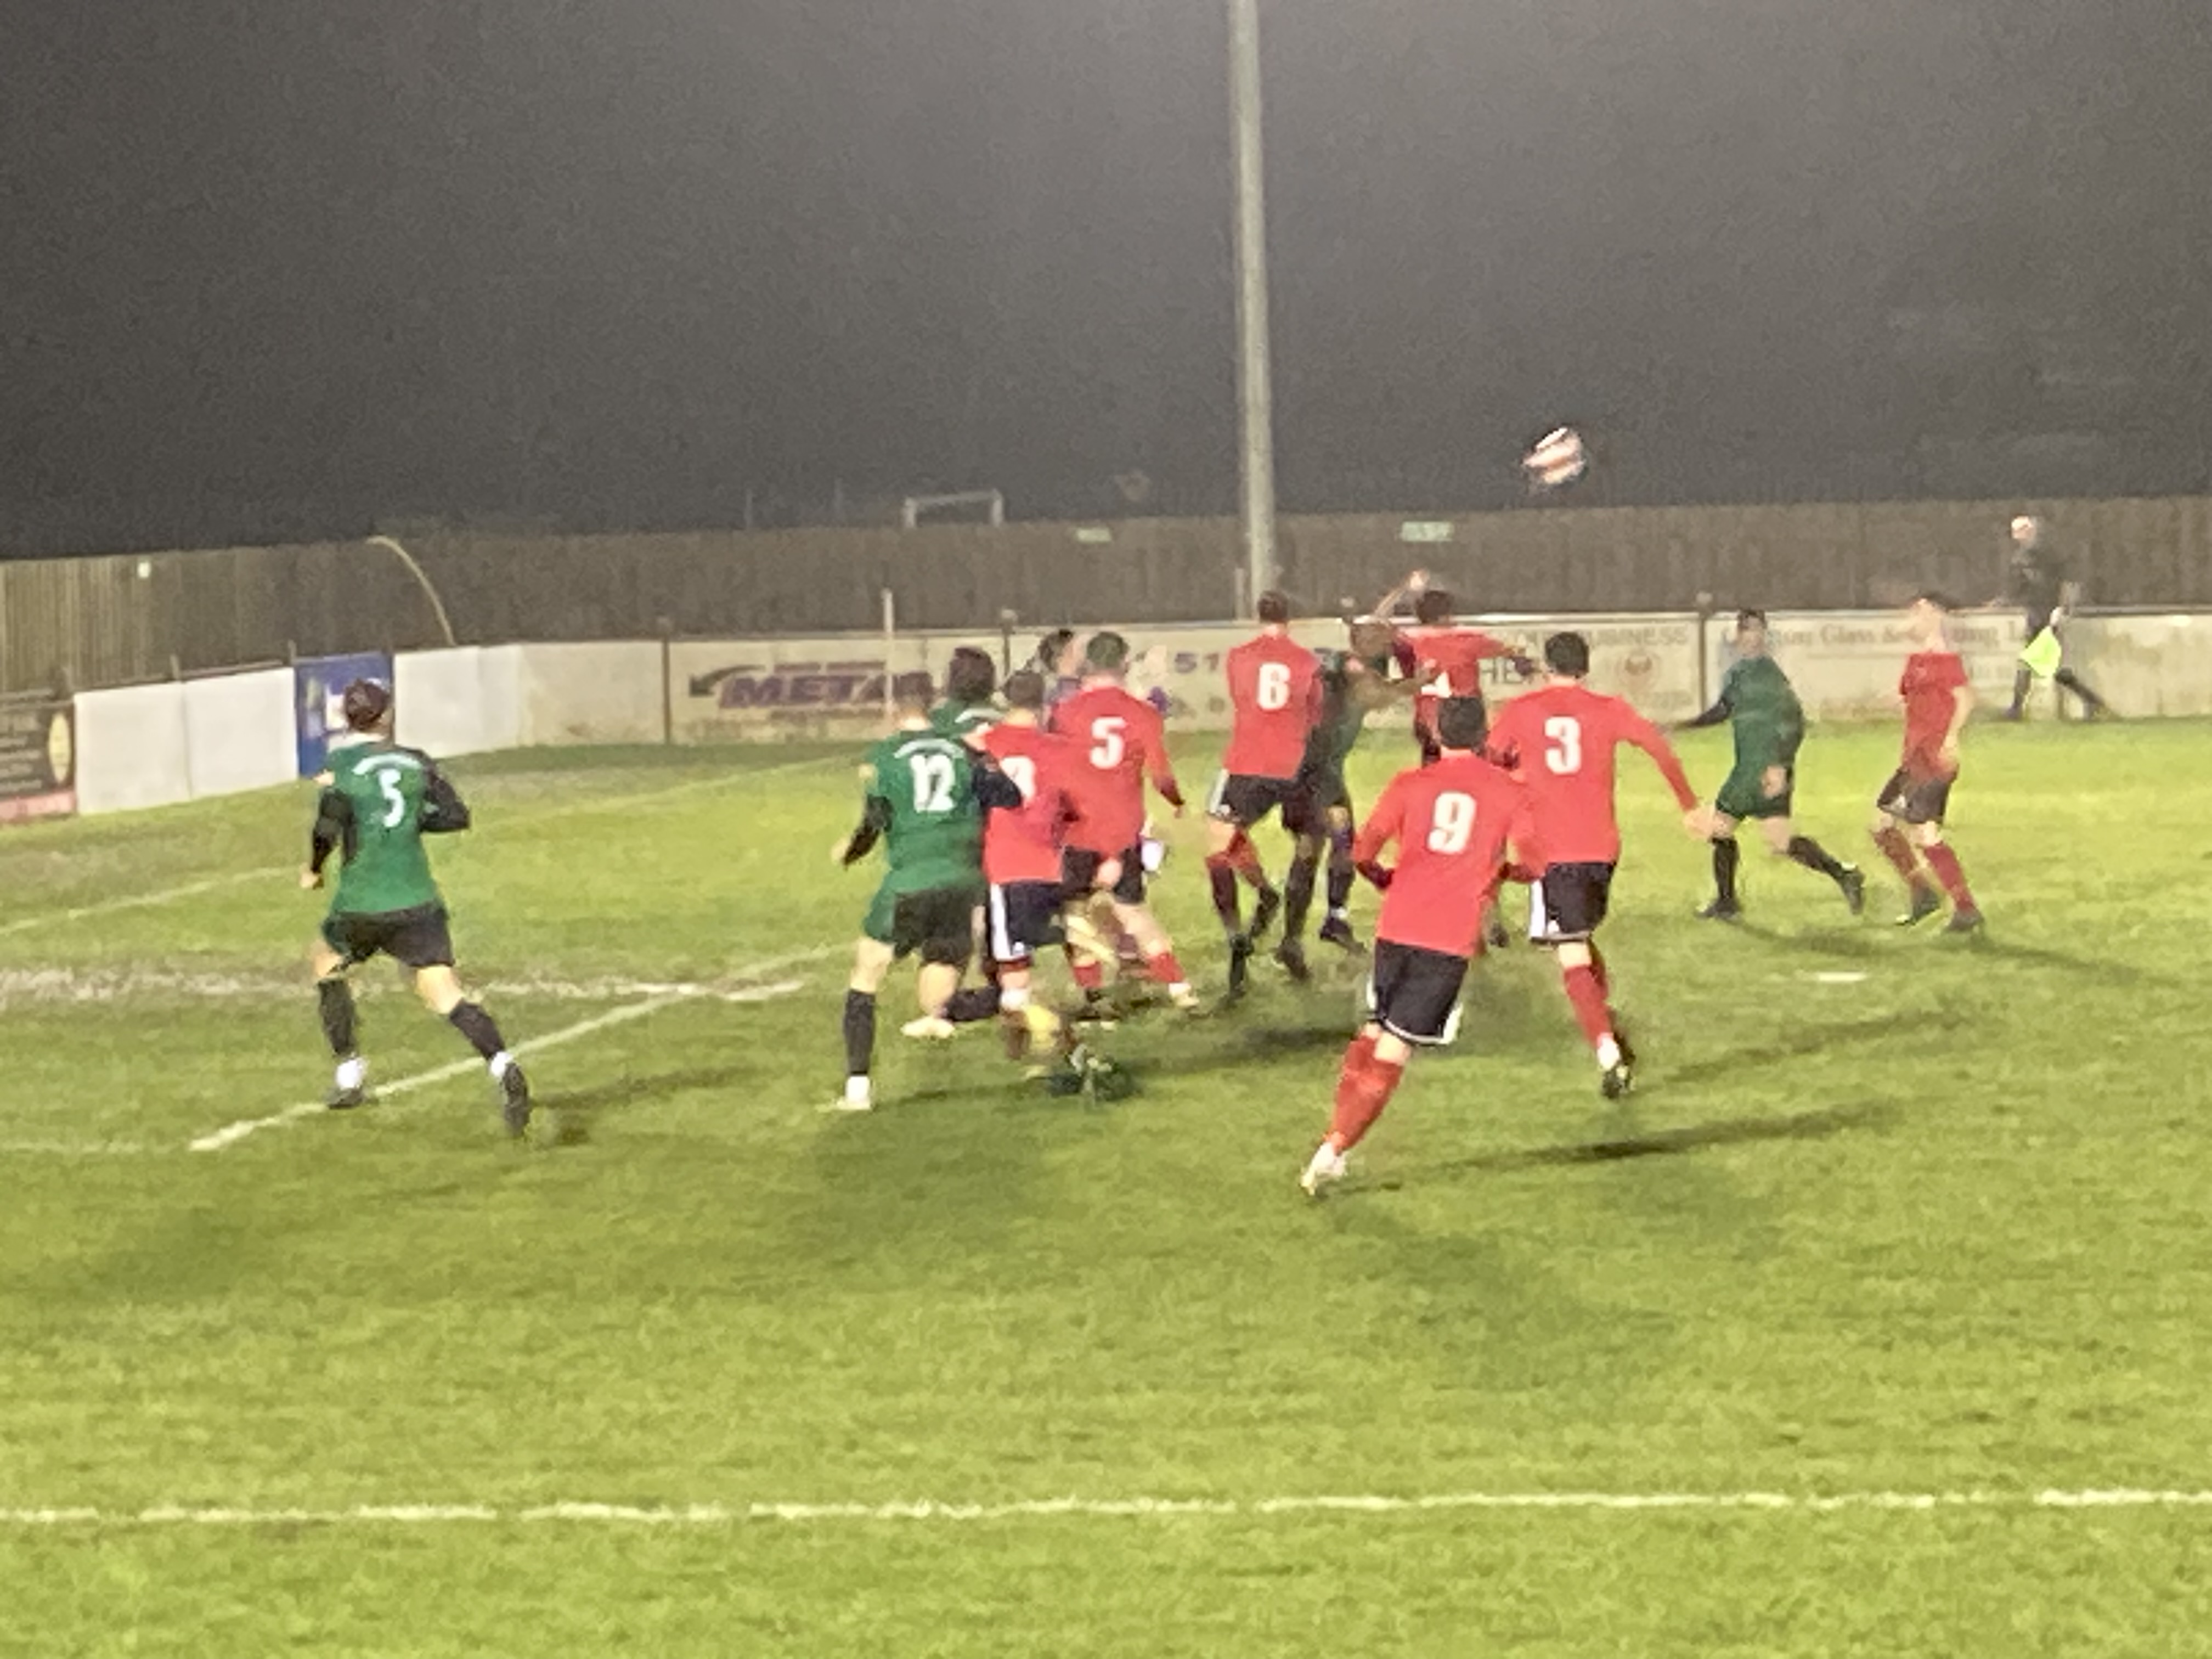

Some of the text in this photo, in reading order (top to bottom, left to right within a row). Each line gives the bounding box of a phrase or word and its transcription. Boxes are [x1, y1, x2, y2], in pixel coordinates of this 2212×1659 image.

[1257, 663, 1290, 710] 6
[1090, 716, 1126, 769] 5
[1544, 716, 1581, 775] 3
[377, 768, 405, 827] 5
[910, 754, 955, 813] 12
[1427, 791, 1476, 854] 9
